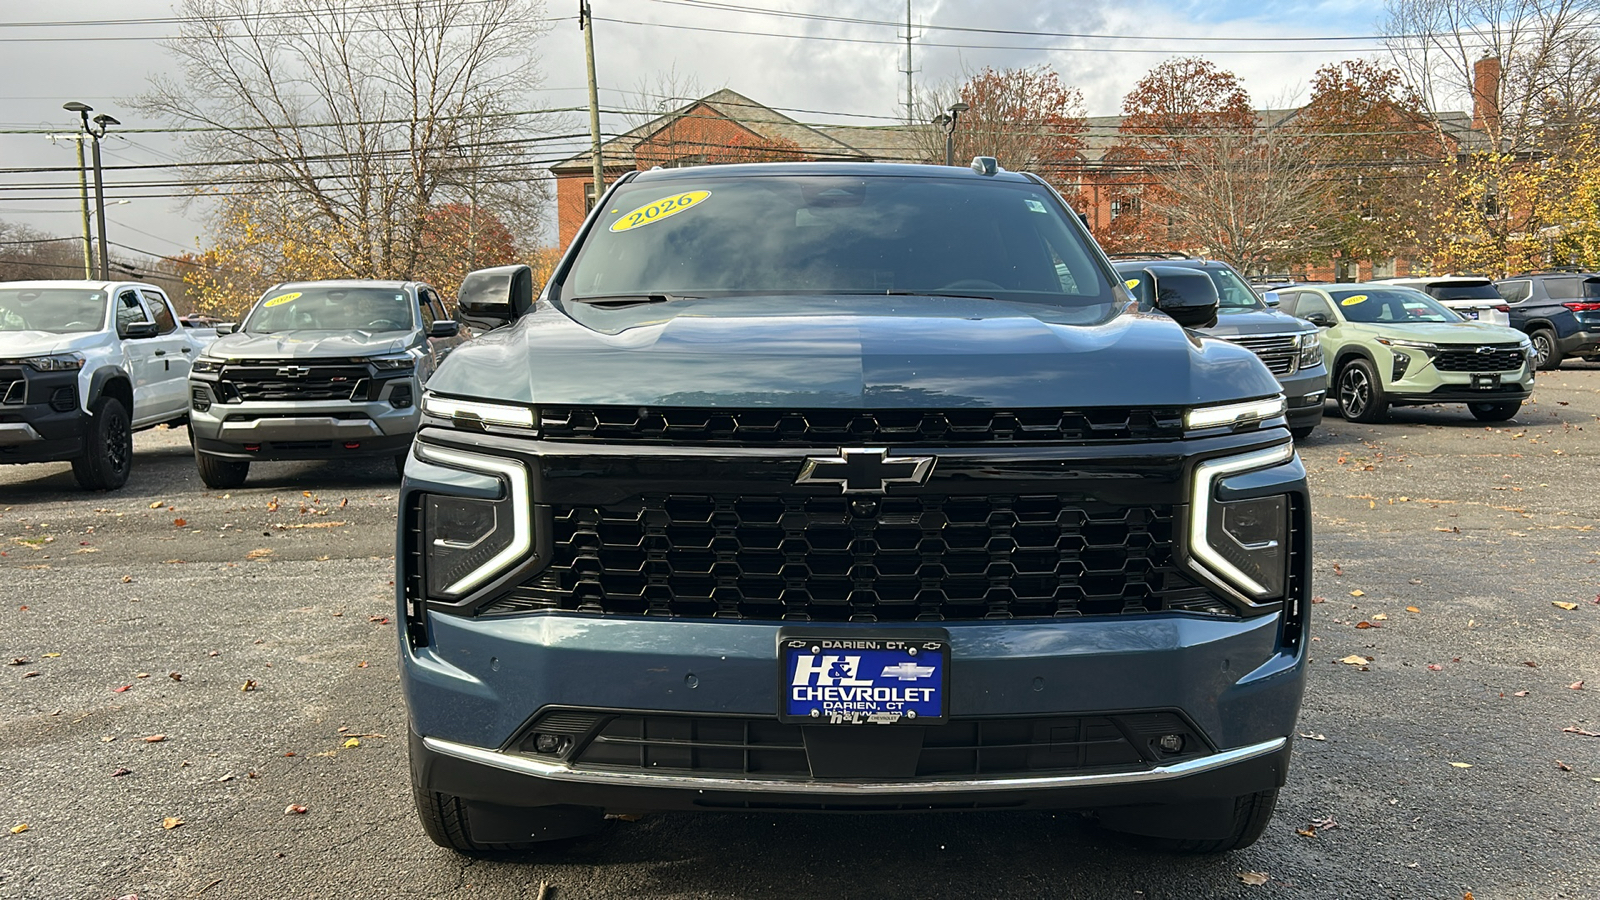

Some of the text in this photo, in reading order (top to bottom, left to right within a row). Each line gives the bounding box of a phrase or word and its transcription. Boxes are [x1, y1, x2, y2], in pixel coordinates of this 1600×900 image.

[628, 193, 693, 227] 2026
[822, 641, 908, 650] DARIEN, CT.
[792, 655, 874, 686] H&L
[793, 687, 936, 702] CHEVROLET
[823, 702, 904, 711] DARIEN, CT
